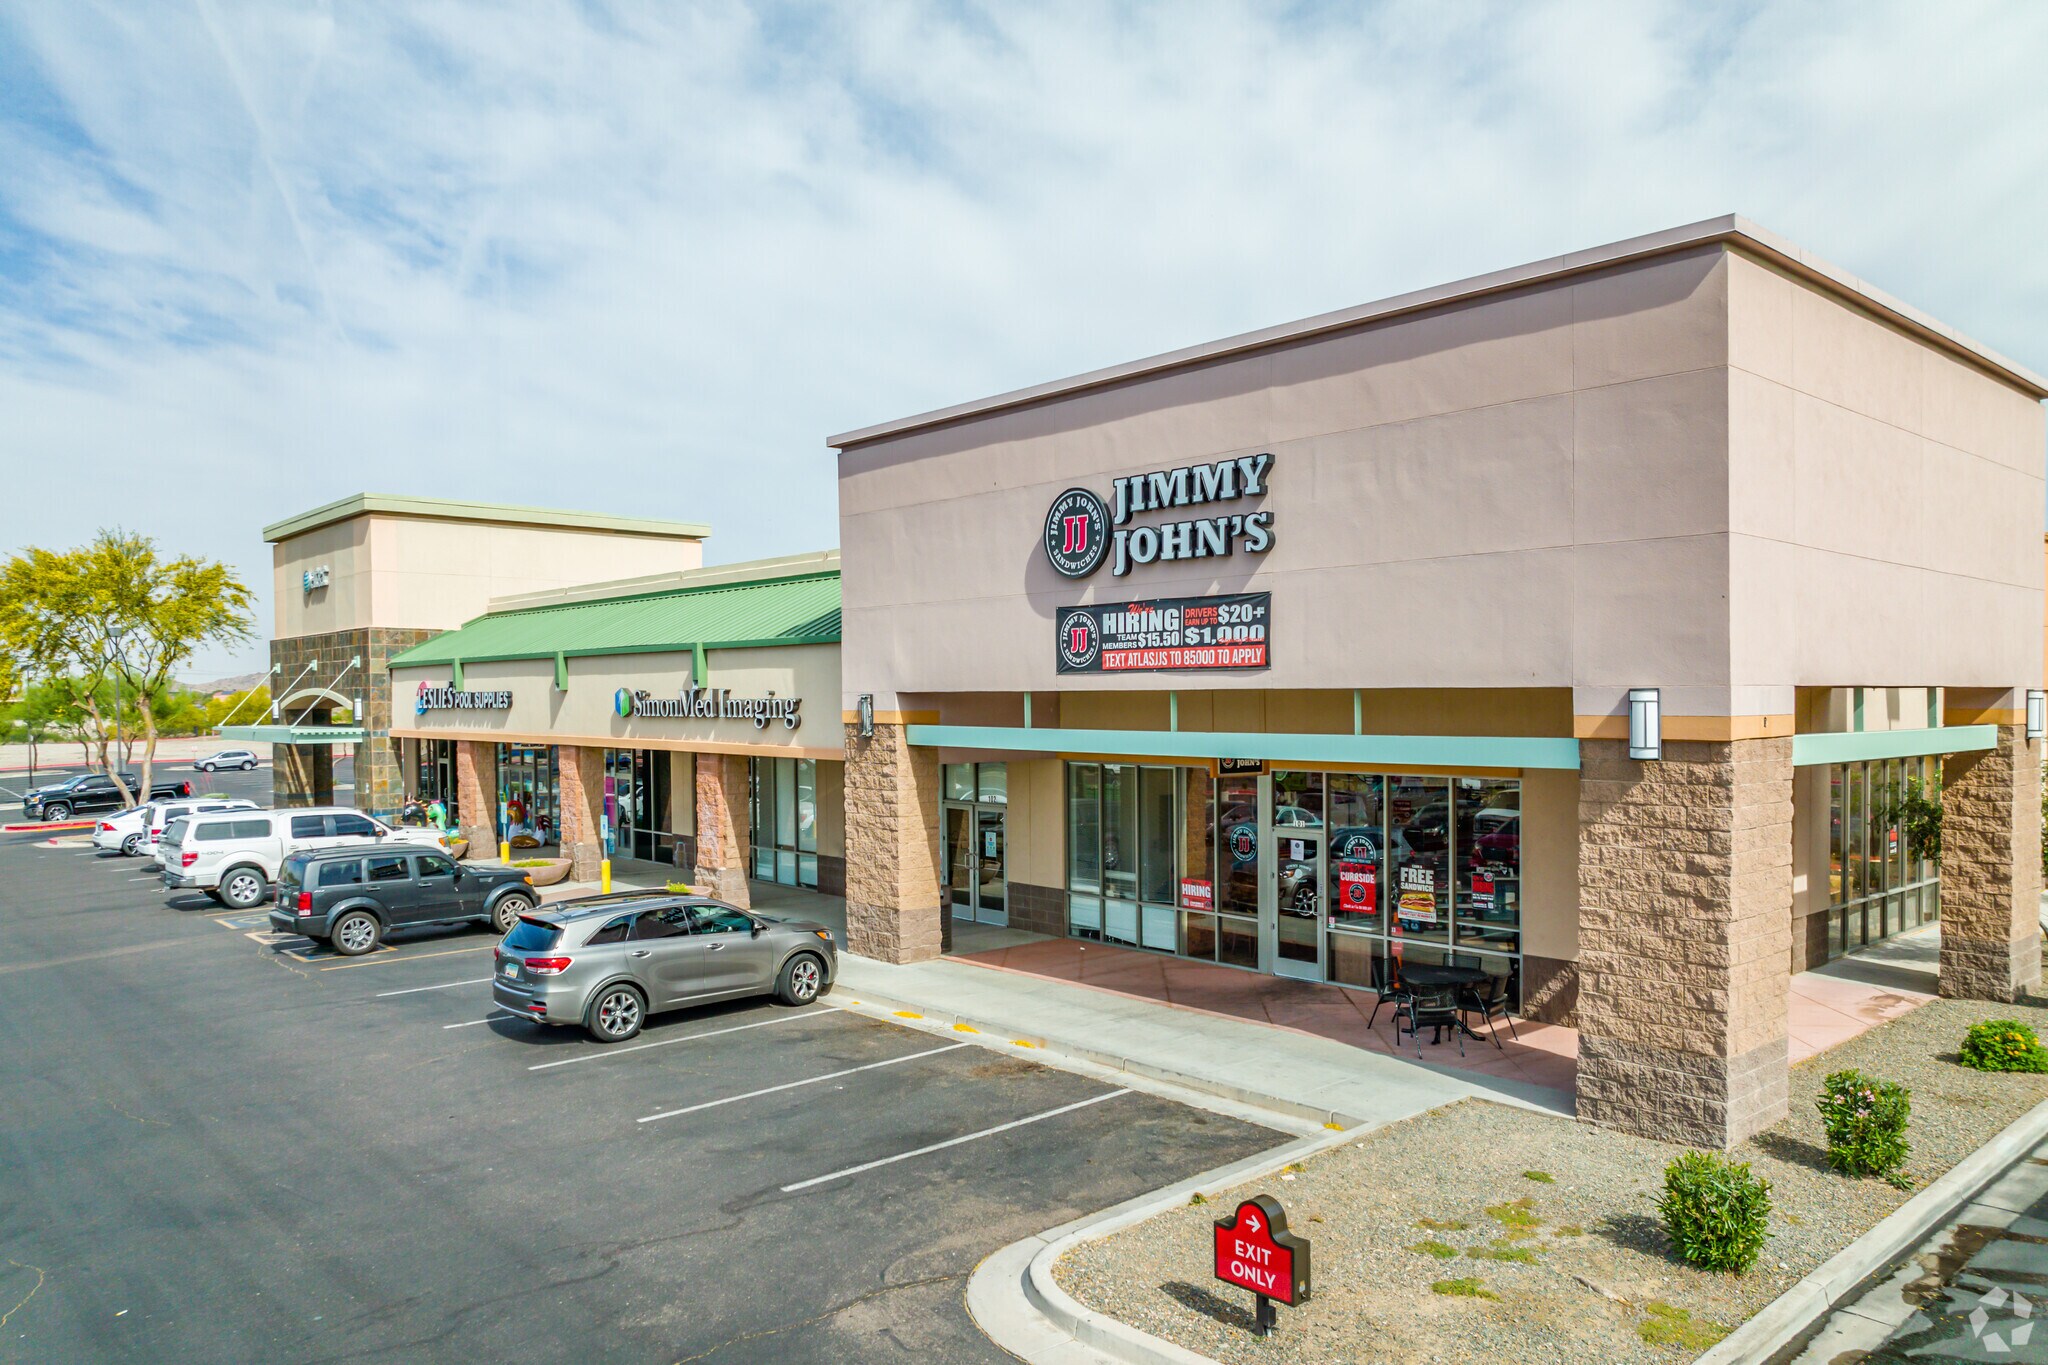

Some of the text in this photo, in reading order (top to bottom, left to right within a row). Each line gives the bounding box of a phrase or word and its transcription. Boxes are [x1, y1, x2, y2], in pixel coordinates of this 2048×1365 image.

[1113, 454, 1272, 525] JIMMY
[1051, 496, 1101, 535] JIMMY JOHN'S
[1063, 514, 1089, 554] JJ
[1113, 512, 1272, 576] JOHN'S
[1053, 545, 1097, 569] SANDWICHES
[1102, 608, 1179, 635] HIRING
[1185, 603, 1265, 625] DRIVERS $20+
[1063, 615, 1078, 640] JIMMY
[1185, 624, 1265, 646] $1,000
[1071, 627, 1088, 653] JJ
[1102, 641, 1137, 650] MEMBERS
[1138, 631, 1179, 648] $15.50
[1105, 647, 1262, 667] TEXT ATLASJJS TO 85000 TO APPLY
[454, 692, 472, 709] POOL
[474, 691, 509, 709] SUPPLIES
[633, 688, 800, 729] SimonMed Imaging
[988, 795, 997, 803] 102
[1340, 871, 1375, 884] CURBSIDE
[1400, 867, 1434, 885] FREE
[1400, 882, 1434, 893] SANDWICH
[1182, 883, 1211, 899] HIRING
[1235, 1239, 1272, 1266] EXIT
[1230, 1260, 1276, 1290] ONLY
